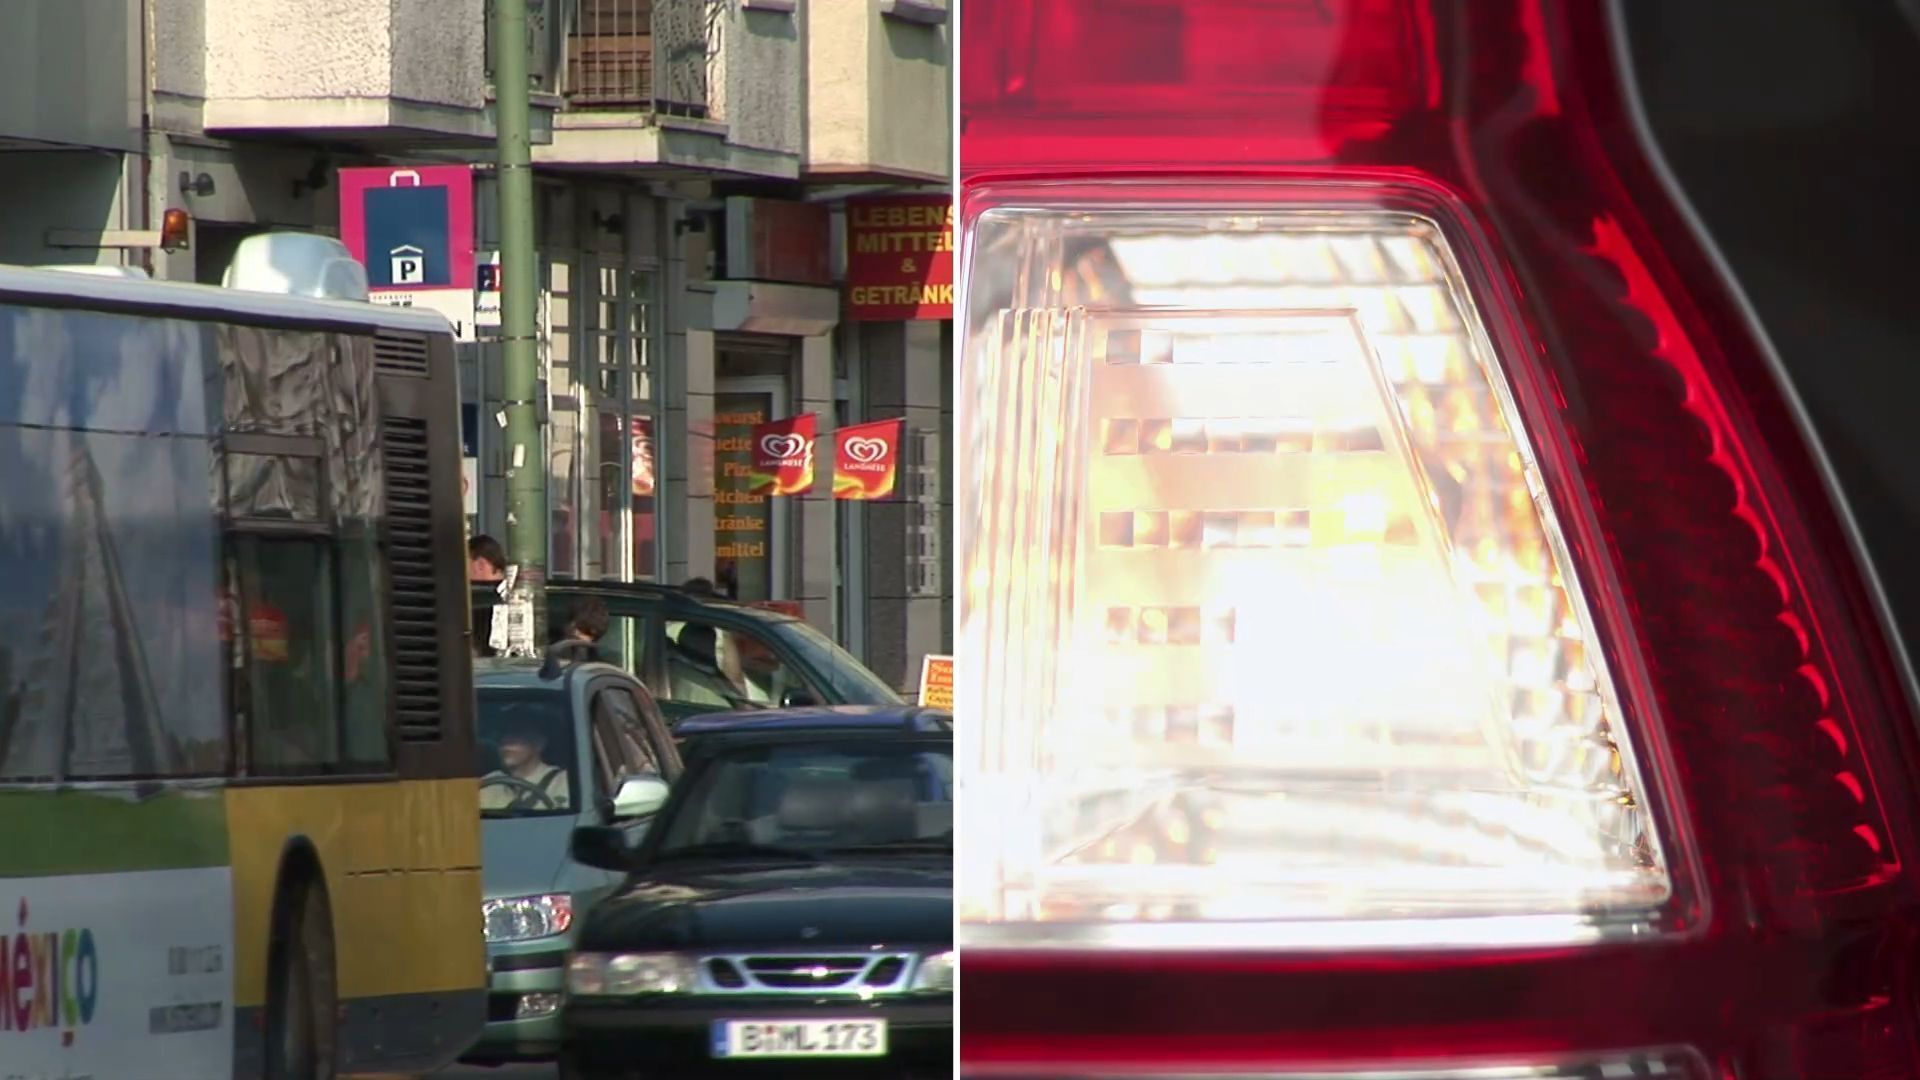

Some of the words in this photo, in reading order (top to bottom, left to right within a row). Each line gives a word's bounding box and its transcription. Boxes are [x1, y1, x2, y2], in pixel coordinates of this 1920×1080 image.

[400, 260, 416, 280] P
[901, 258, 917, 273] &
[822, 1023, 877, 1050] 173
